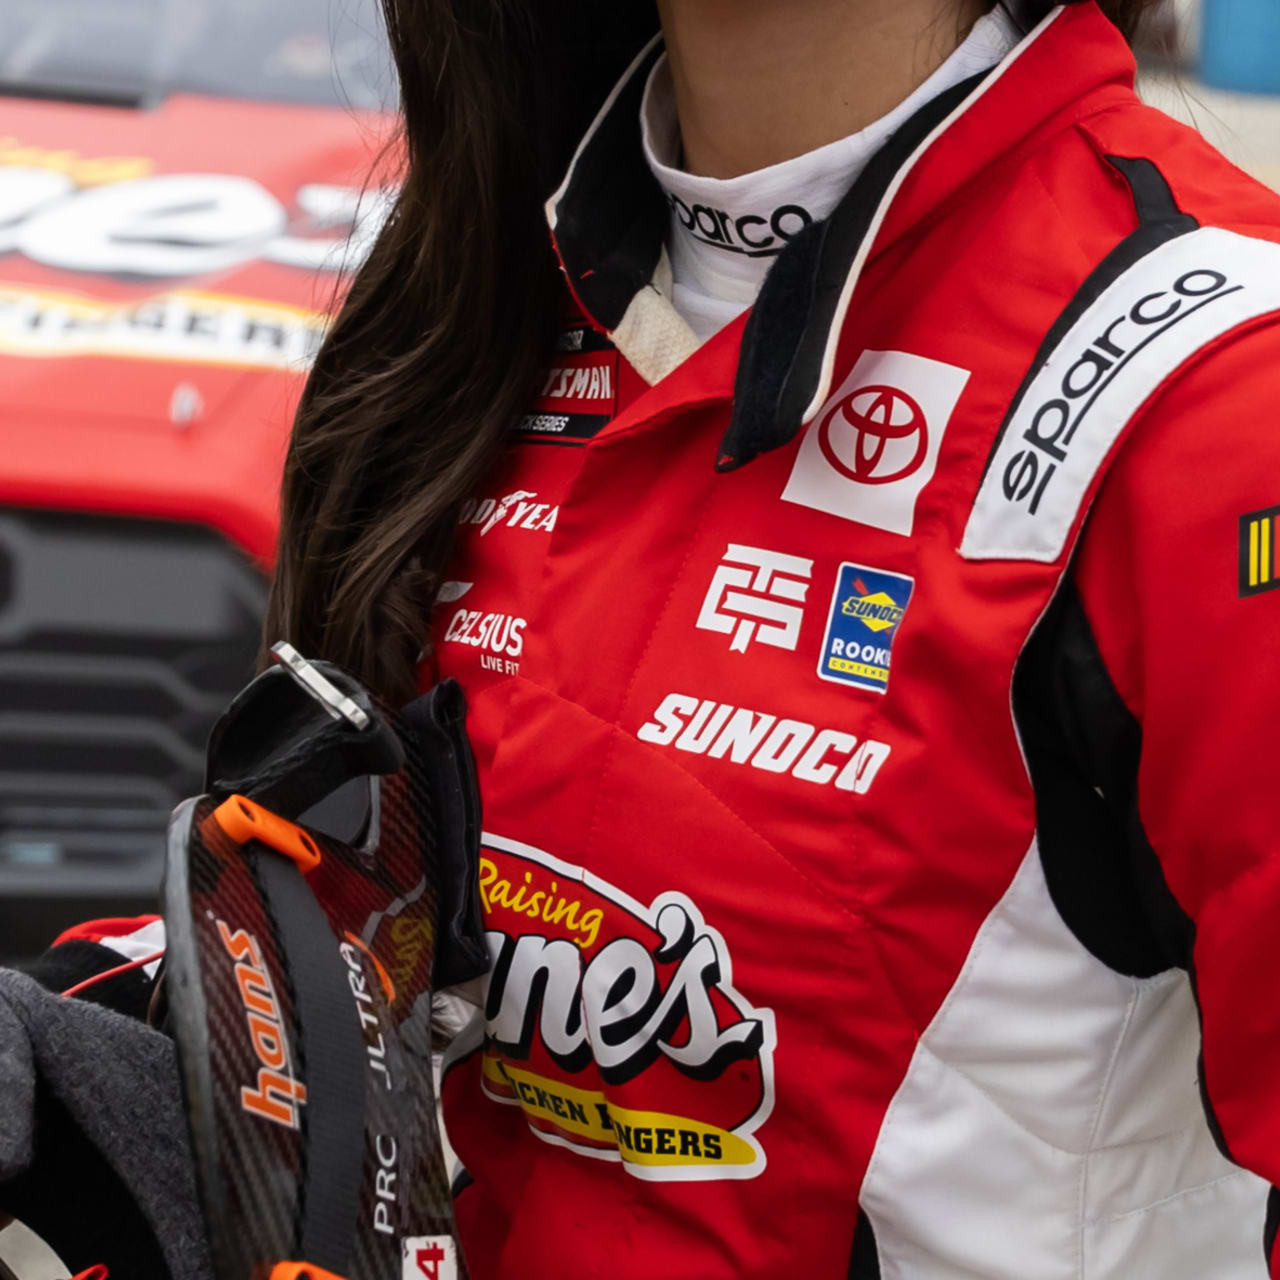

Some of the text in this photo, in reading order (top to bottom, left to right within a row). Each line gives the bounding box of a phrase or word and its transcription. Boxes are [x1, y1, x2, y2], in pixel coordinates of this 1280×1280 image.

[668, 193, 814, 252] parco
[1002, 269, 1232, 510] sparco
[444, 608, 527, 658] CELSIUS
[842, 596, 904, 622] SUNOC
[481, 654, 503, 673] LIVE
[637, 692, 891, 795] SUNOCO
[479, 857, 604, 949] Raising
[217, 919, 309, 1130] hans
